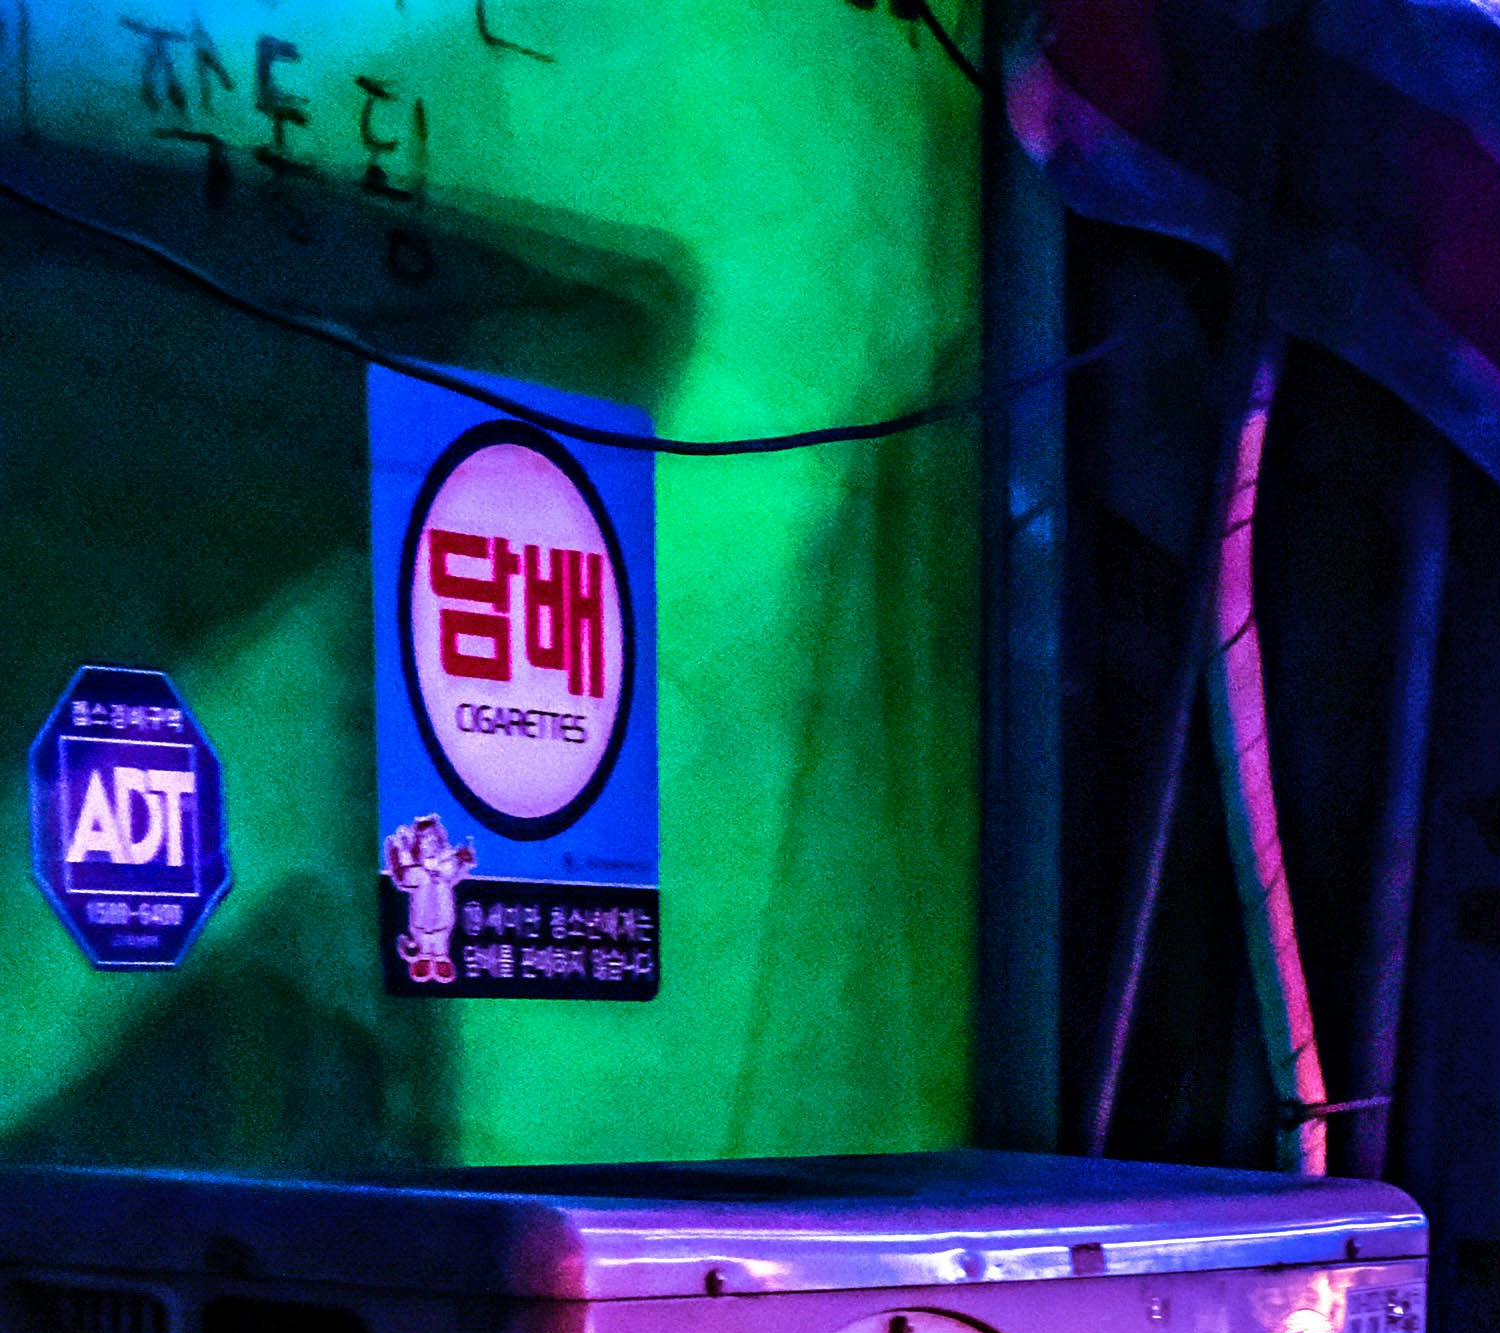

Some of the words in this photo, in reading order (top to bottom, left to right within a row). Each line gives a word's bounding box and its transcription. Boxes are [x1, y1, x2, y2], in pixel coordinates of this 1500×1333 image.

[428, 529, 604, 699] 담배
[456, 702, 587, 745] CIGARETTES
[65, 766, 195, 867] ADT
